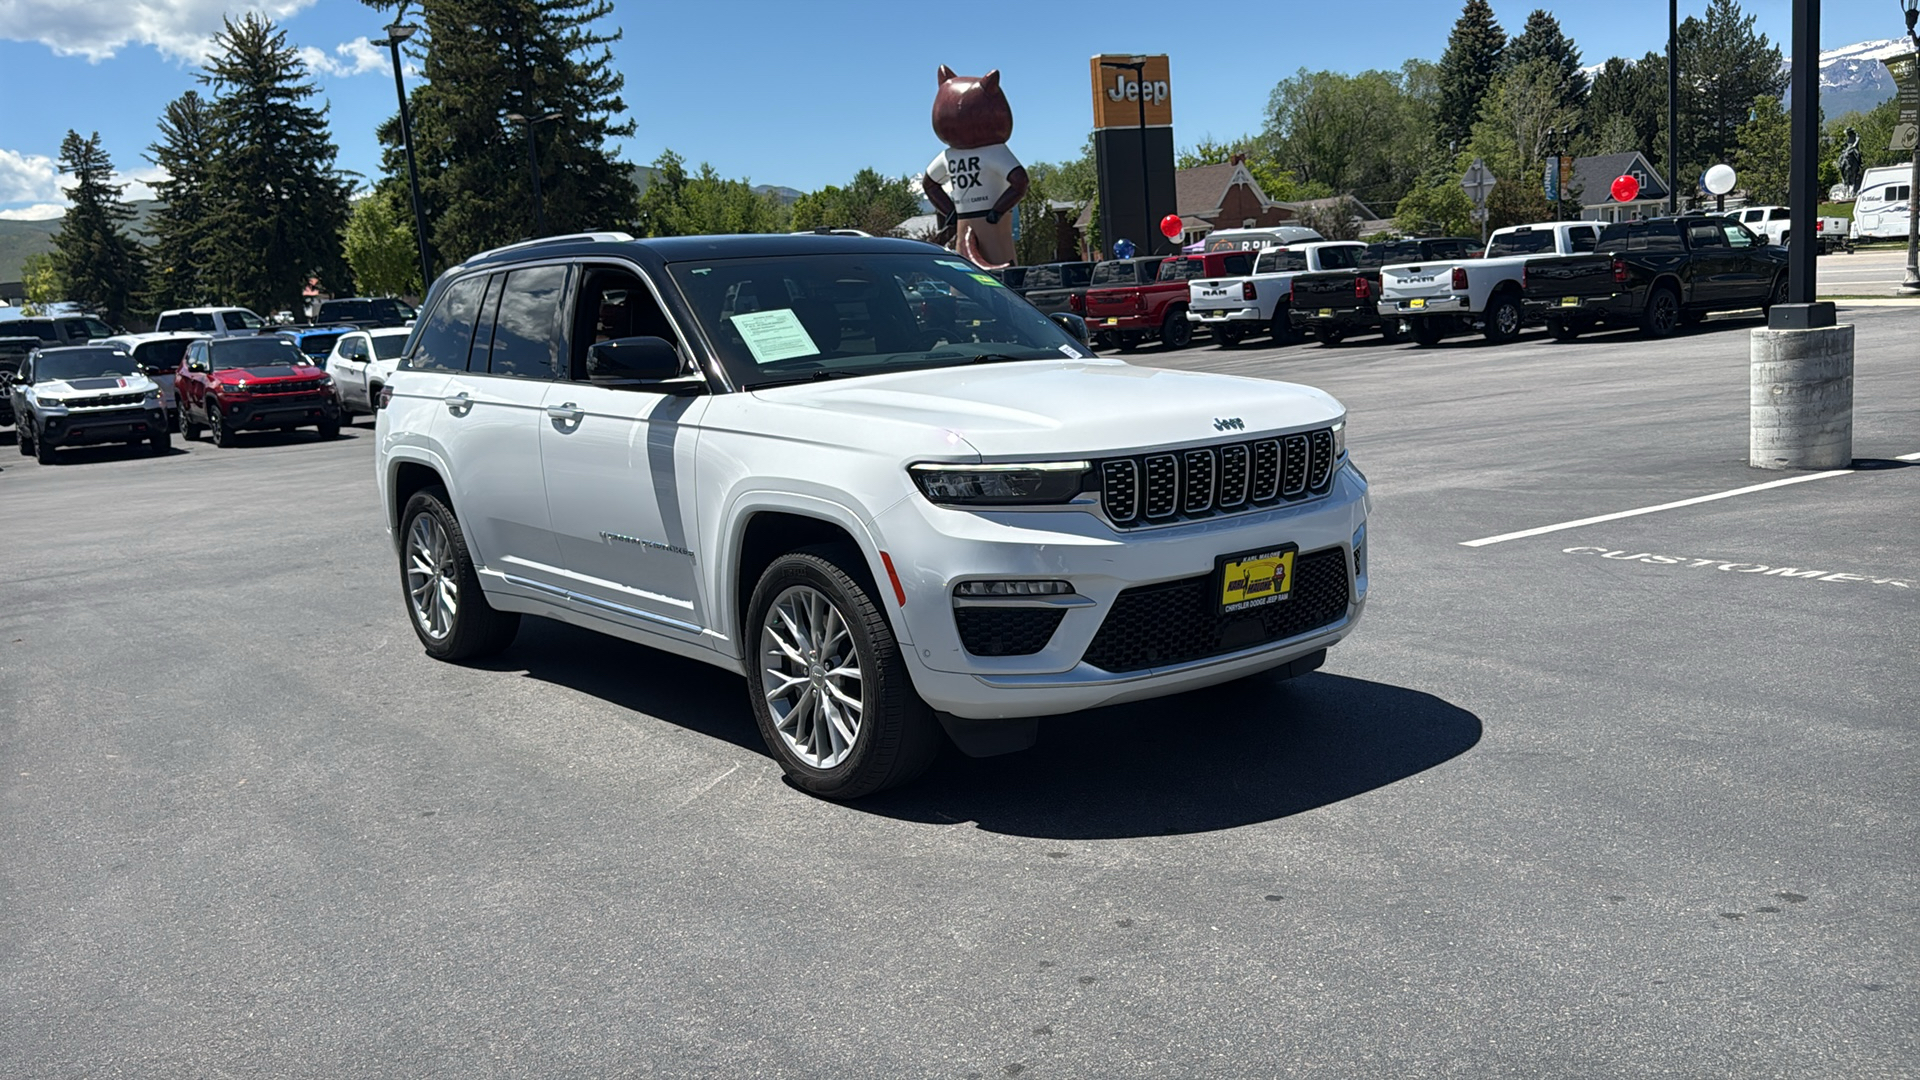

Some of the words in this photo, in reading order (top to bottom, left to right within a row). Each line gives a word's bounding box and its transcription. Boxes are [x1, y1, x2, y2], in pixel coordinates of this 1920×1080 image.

[1108, 75, 1168, 106] Jeep
[948, 156, 981, 174] CAR
[950, 171, 983, 191] FOX
[1202, 289, 1227, 297] RAM
[1213, 417, 1245, 432] Jeep
[1225, 601, 1250, 613] CHRYSLER
[1250, 597, 1266, 608] DODGE
[1266, 595, 1278, 604] JEEP
[1277, 593, 1289, 601] RAM
